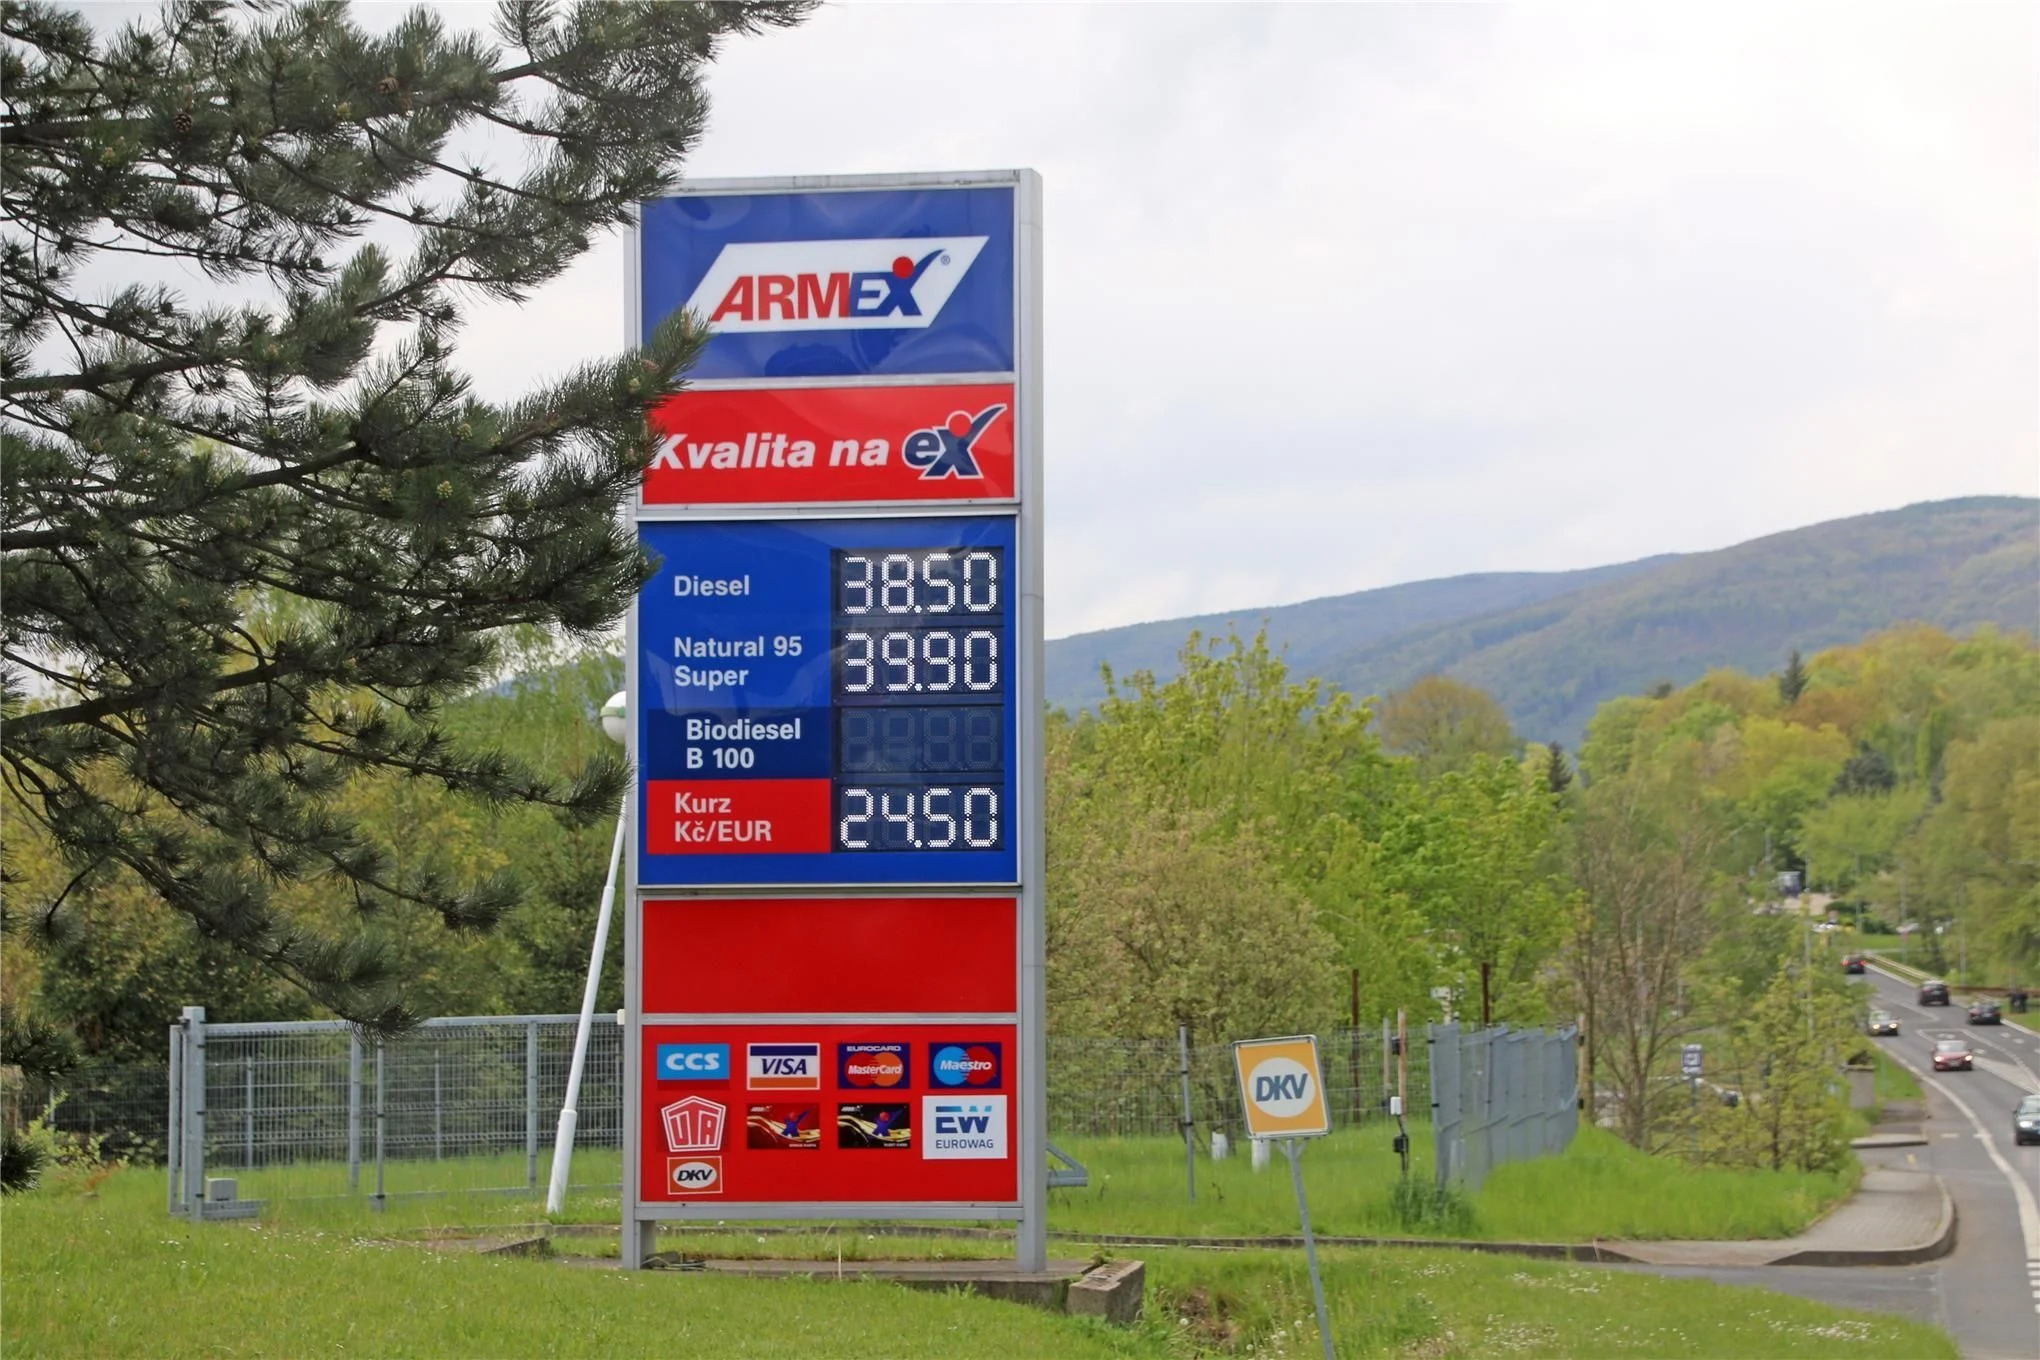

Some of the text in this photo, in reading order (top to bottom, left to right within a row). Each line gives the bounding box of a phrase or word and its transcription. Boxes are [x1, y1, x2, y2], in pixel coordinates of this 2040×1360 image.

[710, 249, 946, 321] ARMEX
[648, 432, 816, 470] Kvalita
[828, 437, 889, 467] na
[674, 575, 750, 596] Diesel
[844, 551, 997, 615] 38.50
[673, 635, 803, 657] Natural 95
[844, 630, 998, 692] 39.90
[674, 665, 749, 691] Super
[686, 718, 801, 740] Biodiesel
[686, 748, 755, 769] B 100
[674, 792, 732, 814] Kurz
[839, 787, 998, 849] 24.50
[674, 820, 772, 843] Kč/EUR
[665, 1052, 720, 1071] CCS
[761, 1058, 807, 1076] VISA
[848, 1064, 903, 1076] MasterCard
[939, 1060, 993, 1071] Maestro
[1255, 1073, 1308, 1102] DKV
[935, 1105, 993, 1134] EW
[936, 1139, 994, 1149] EUROWAG
[677, 1169, 713, 1182] DKV
